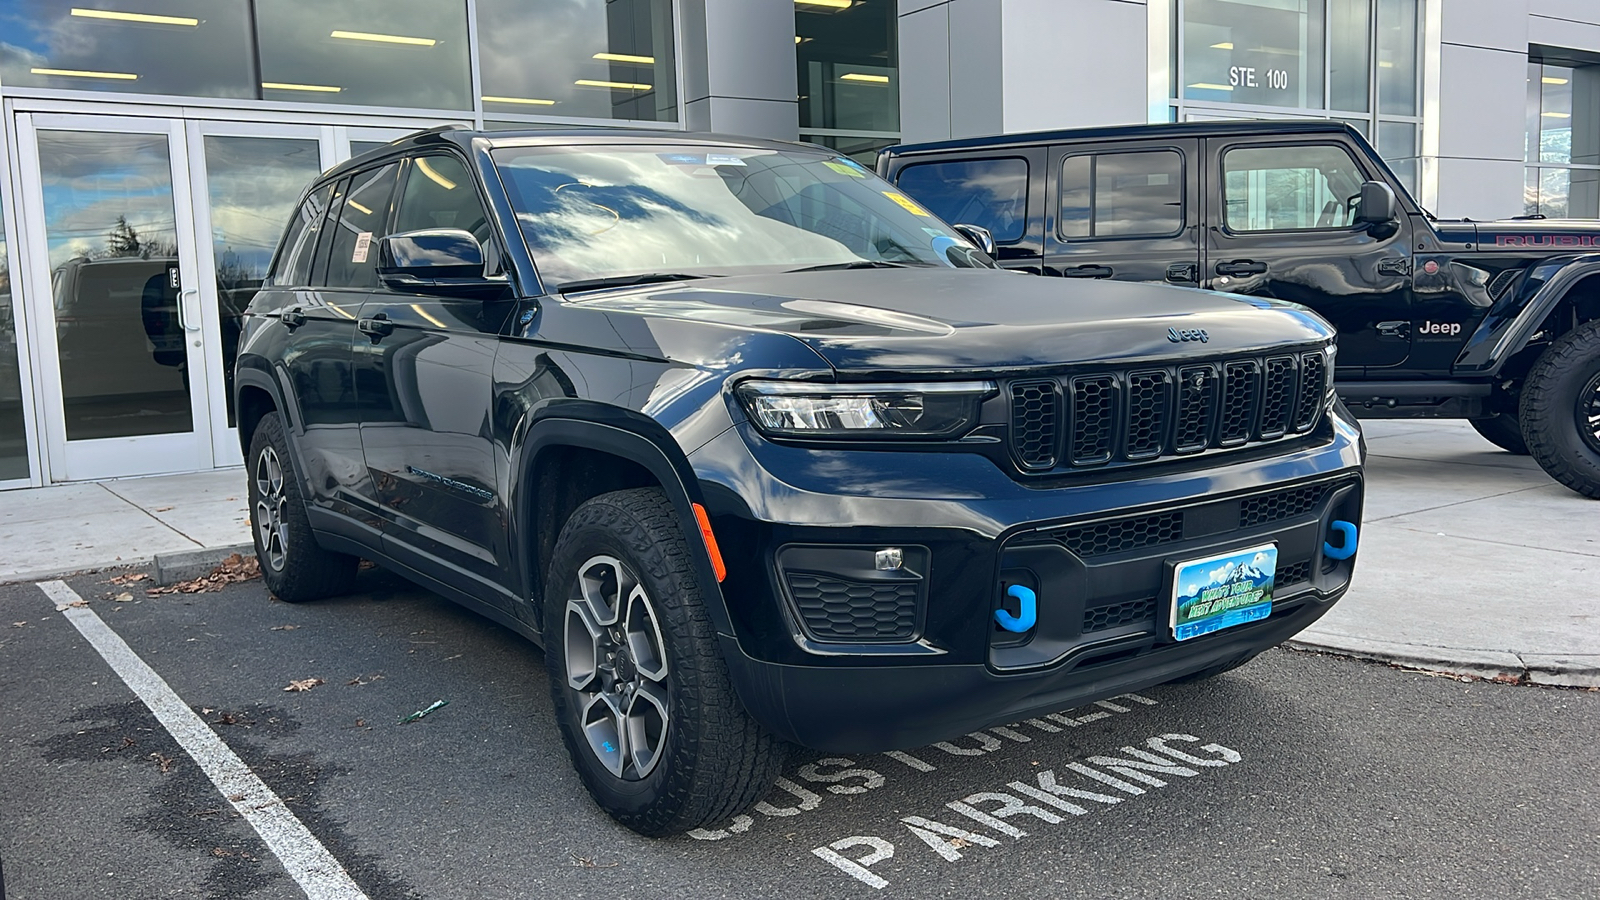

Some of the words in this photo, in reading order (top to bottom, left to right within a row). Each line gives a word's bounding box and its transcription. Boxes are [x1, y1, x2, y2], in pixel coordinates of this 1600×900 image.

[1230, 66, 1259, 88] STE.
[1266, 68, 1288, 90] 100
[1495, 235, 1600, 248] RUBI
[1166, 326, 1210, 344] Jeep
[1419, 320, 1461, 335] Jeep
[1230, 580, 1254, 596] YOUR
[1188, 602, 1211, 619] NEXT
[1210, 590, 1264, 613] ADVENTURE?
[812, 732, 1242, 890] PARKING
